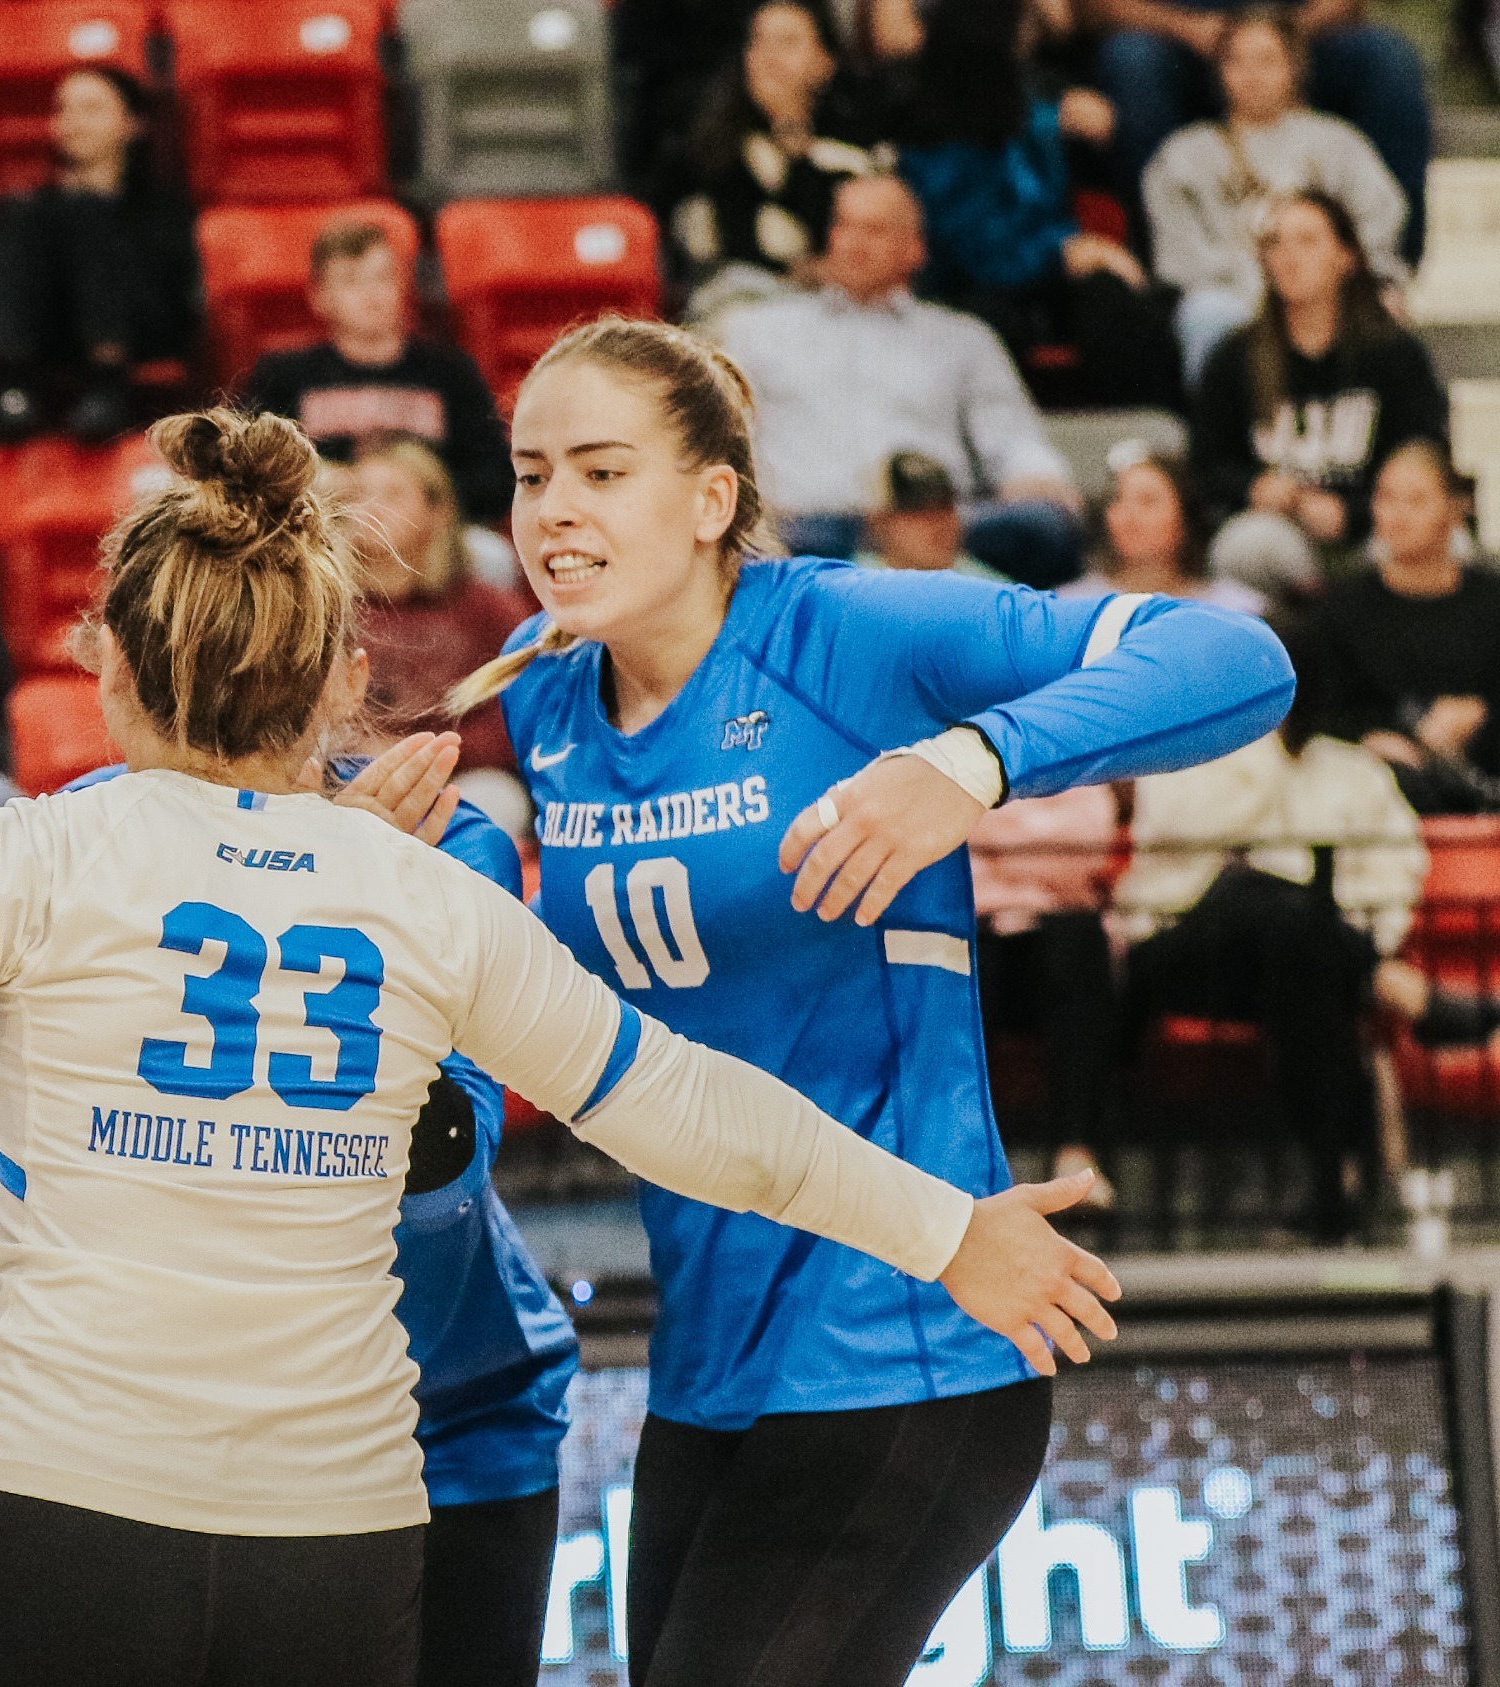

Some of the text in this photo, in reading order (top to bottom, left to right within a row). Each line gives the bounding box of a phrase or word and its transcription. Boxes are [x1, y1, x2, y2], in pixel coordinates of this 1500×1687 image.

[541, 775, 770, 848] BLUE RAIDERS
[585, 856, 710, 989] 10
[137, 901, 384, 1111] 33
[87, 1106, 389, 1178] MIDDLE TENNESSEE
